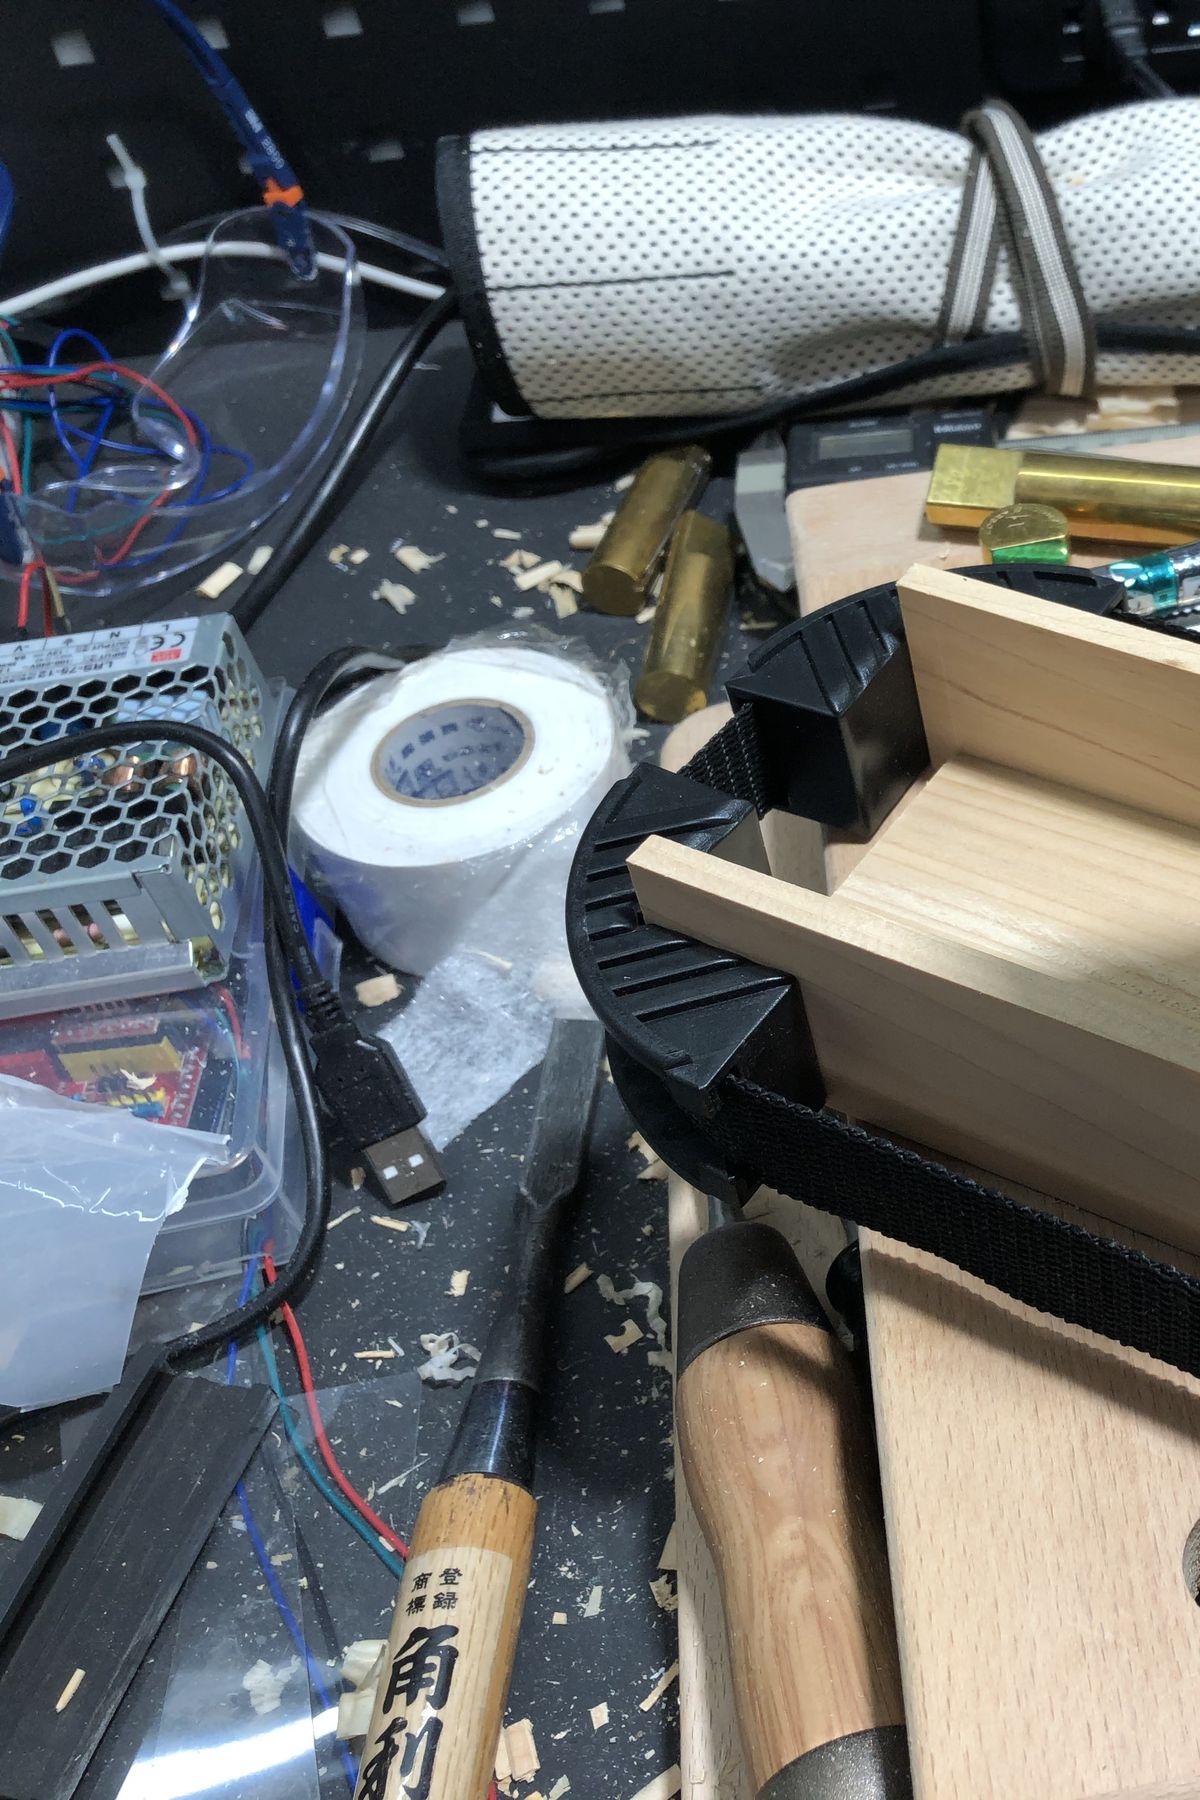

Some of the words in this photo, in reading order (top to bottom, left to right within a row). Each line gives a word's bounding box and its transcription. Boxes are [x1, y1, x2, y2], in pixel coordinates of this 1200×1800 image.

[405, 1571, 433, 1617] 商標
[432, 1566, 463, 1611] 登録
[356, 1624, 460, 1800] 角利
